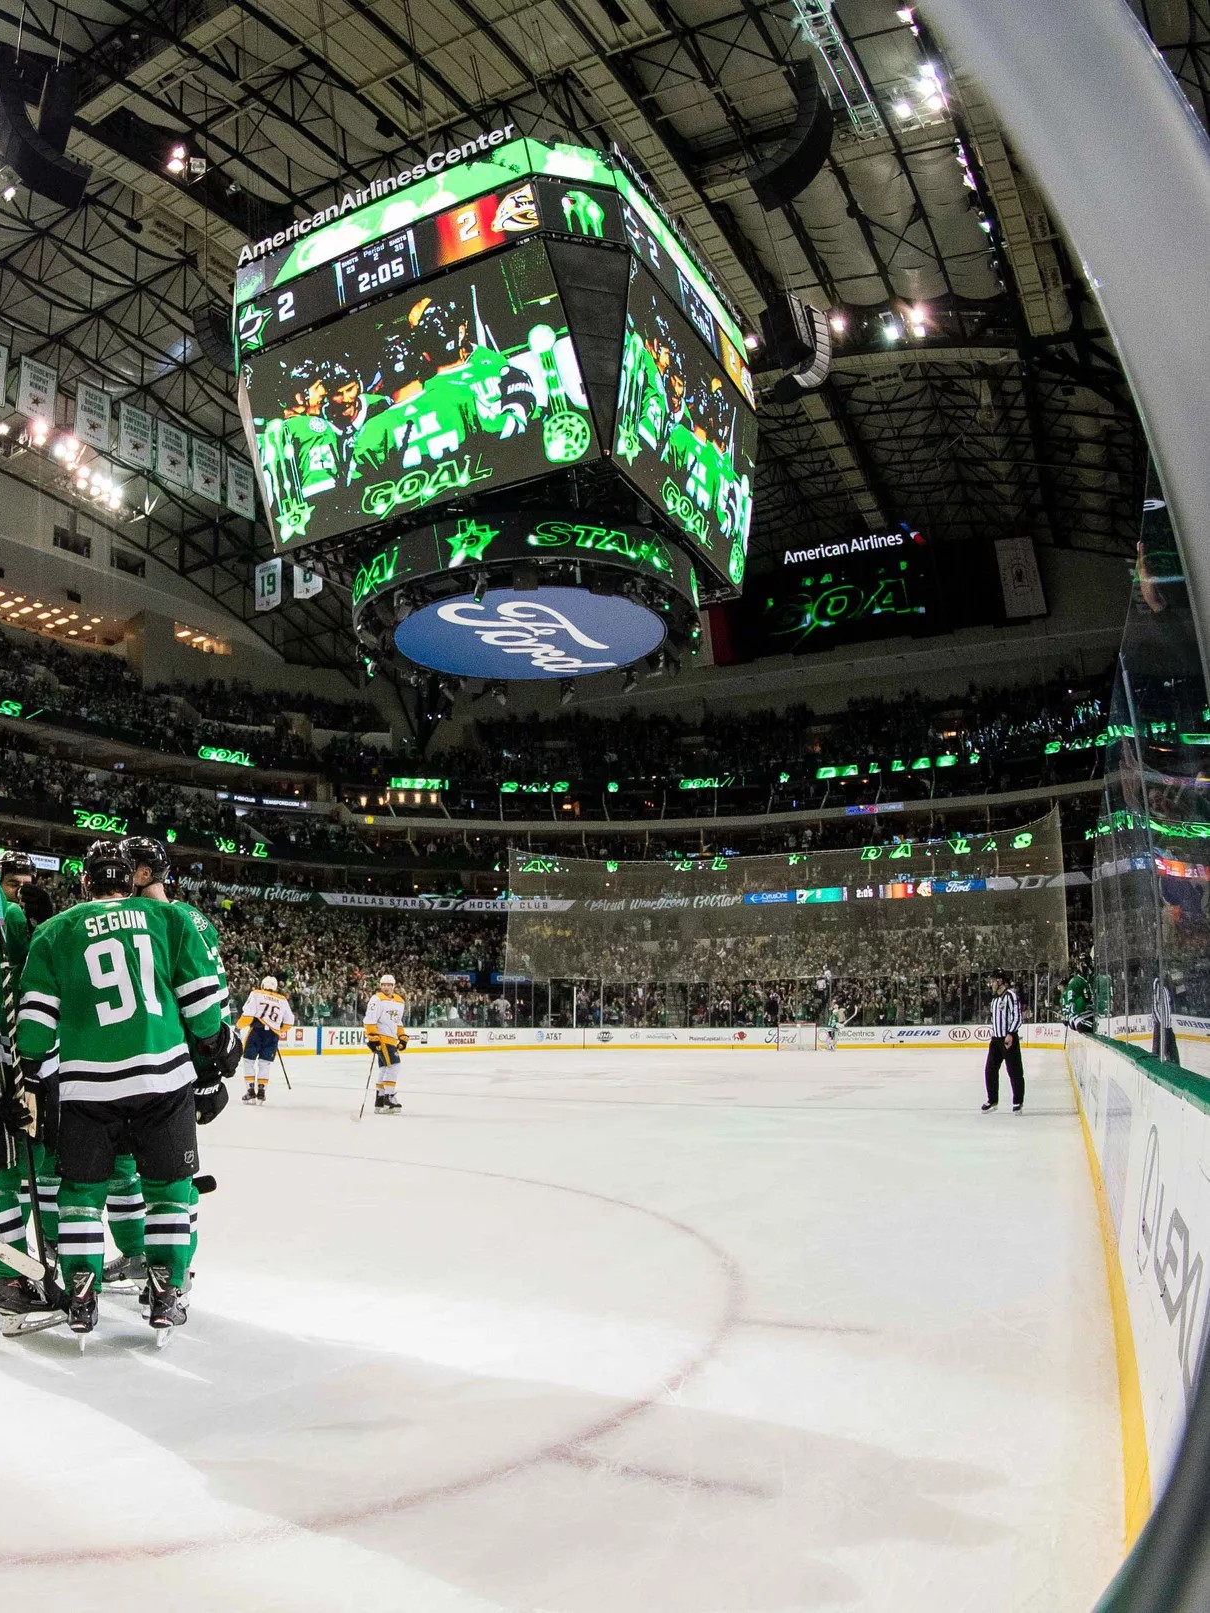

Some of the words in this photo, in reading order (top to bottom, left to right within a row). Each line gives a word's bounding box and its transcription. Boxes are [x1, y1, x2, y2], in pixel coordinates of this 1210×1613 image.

[237, 123, 515, 266] AmericanAirlinesCenter
[456, 210, 479, 243] 2
[363, 243, 385, 258] Period
[358, 257, 405, 293] 2:05
[277, 291, 296, 323] 2
[361, 453, 494, 519] GOAL
[783, 541, 850, 565] American
[850, 531, 903, 554] Airlines
[260, 572, 276, 597] 19
[437, 601, 617, 672] Ford
[106, 868, 117, 879] 91
[945, 880, 971, 893] Ford
[342, 896, 384, 906] DALLAS
[390, 897, 424, 907] STARS
[469, 900, 513, 910] HOCKEY
[520, 902, 549, 910] CLUB
[84, 911, 148, 938] SEGUIN
[84, 934, 163, 1027] 91
[258, 1002, 279, 1023] 76
[545, 1032, 562, 1041] AT&T
[897, 1029, 941, 1037] BOEING
[952, 1030, 967, 1039] KIA
